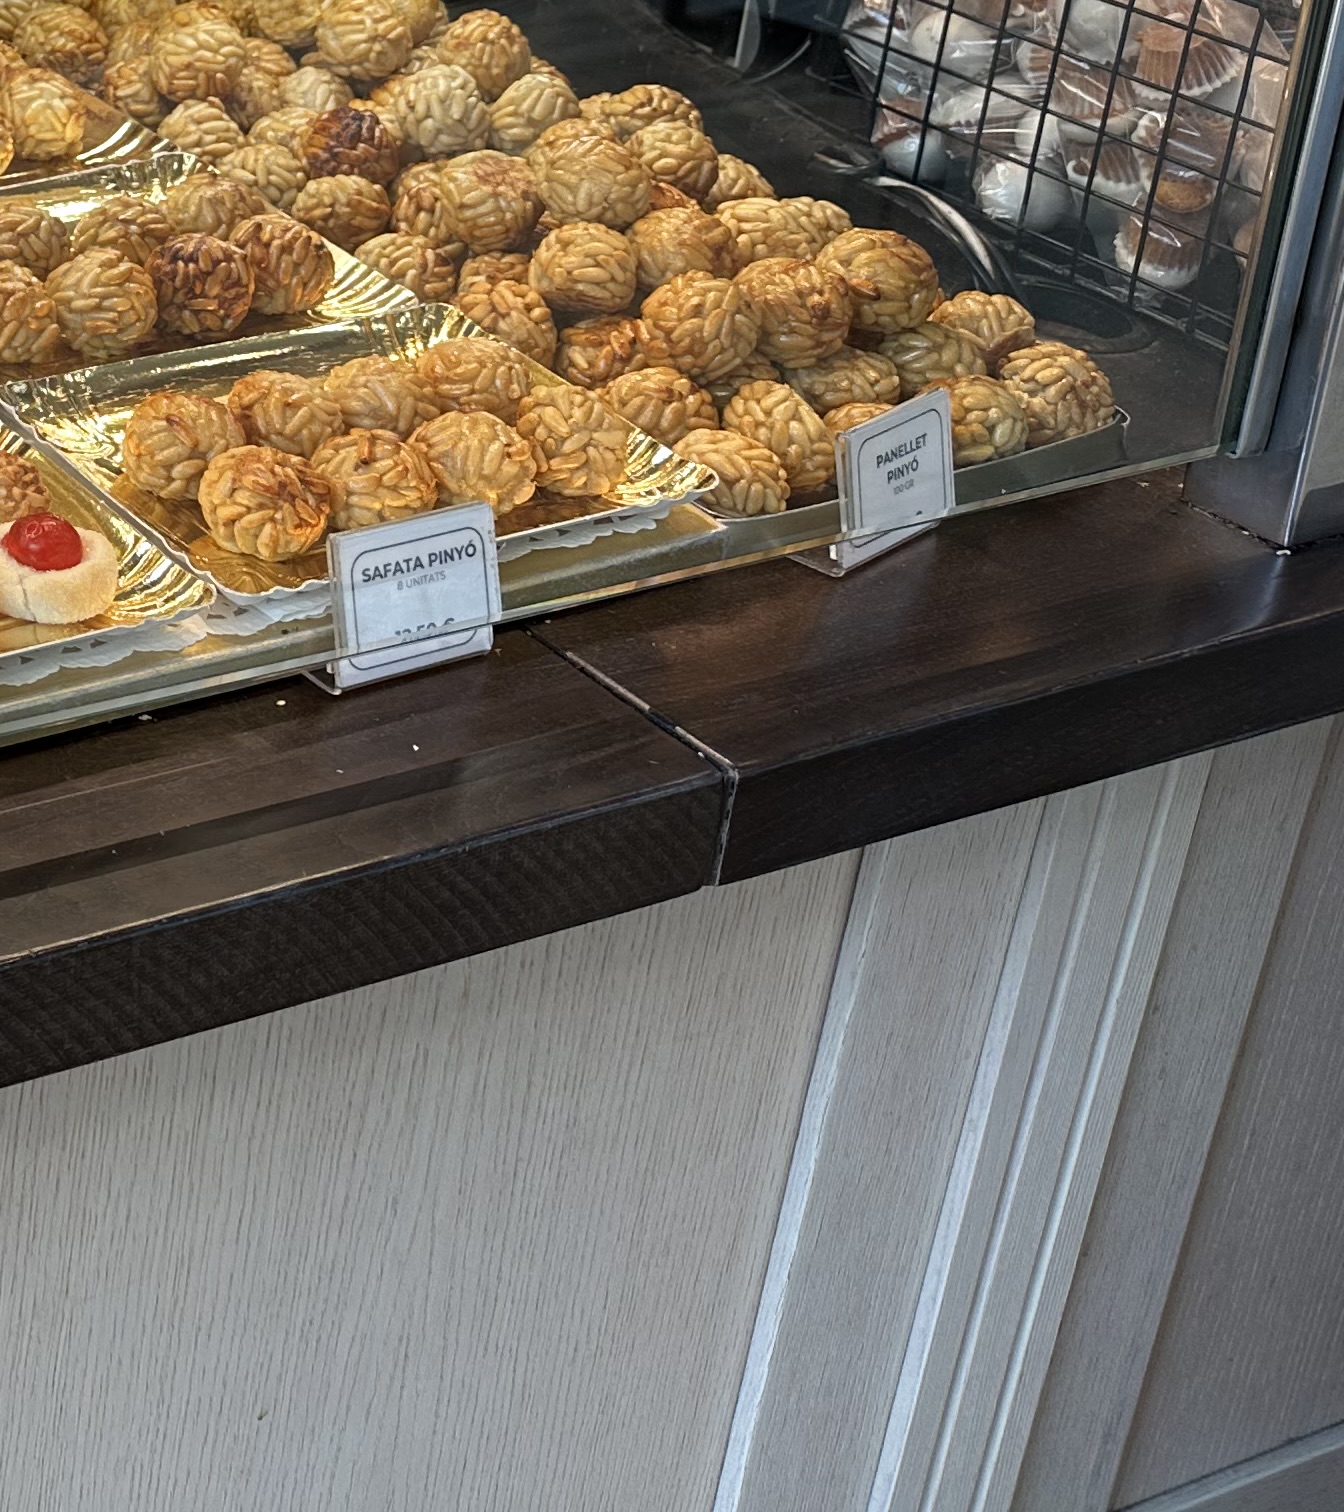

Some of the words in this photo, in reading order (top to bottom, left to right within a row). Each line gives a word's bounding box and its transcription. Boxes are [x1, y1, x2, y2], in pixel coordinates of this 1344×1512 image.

[876, 433, 928, 469] PANELLET
[887, 455, 919, 484] PINYÓ
[361, 555, 425, 583] SAFATA
[428, 539, 477, 568] PINYÓ
[406, 570, 447, 589] UNITATS
